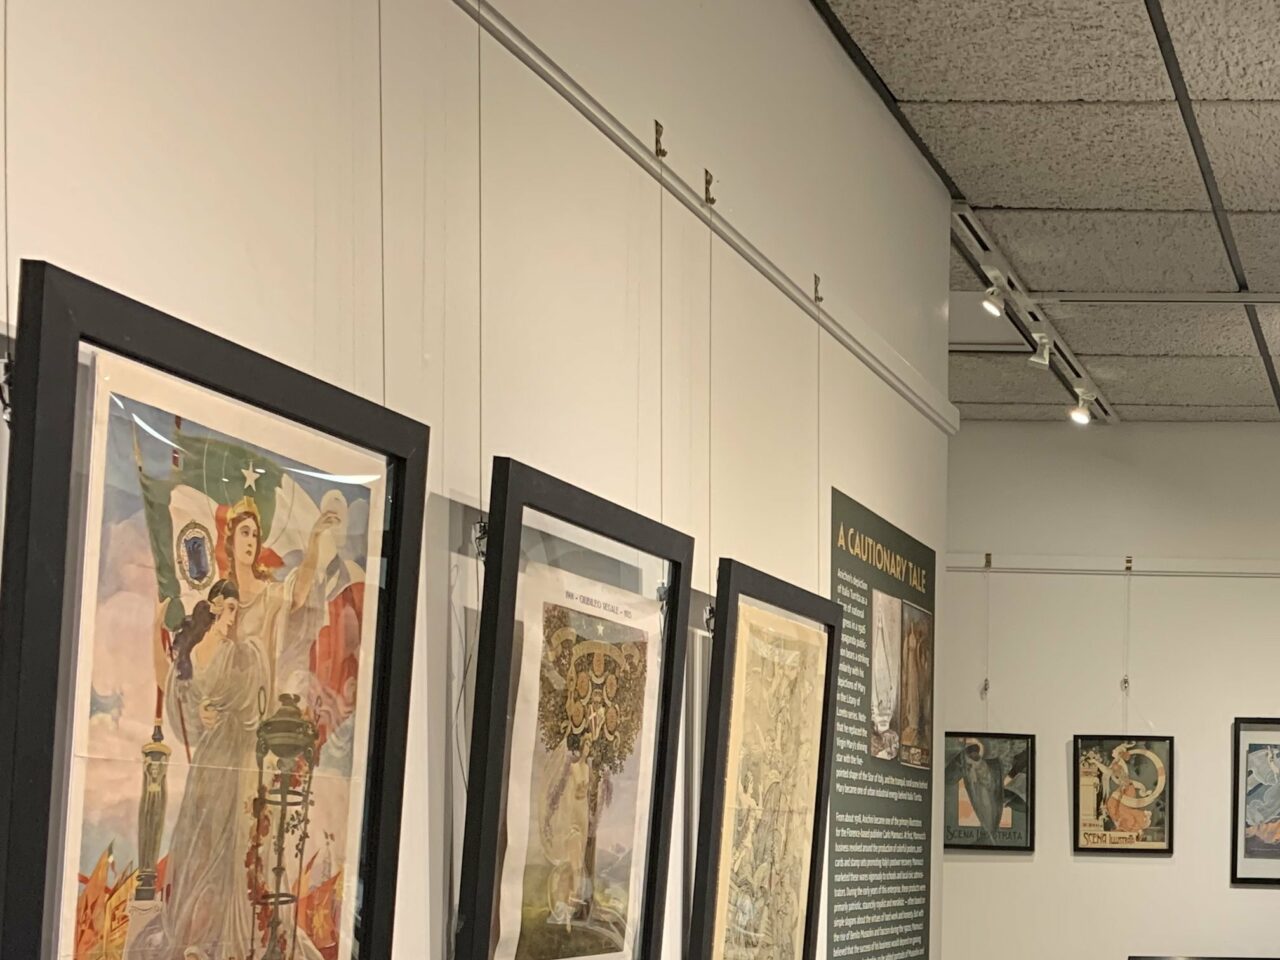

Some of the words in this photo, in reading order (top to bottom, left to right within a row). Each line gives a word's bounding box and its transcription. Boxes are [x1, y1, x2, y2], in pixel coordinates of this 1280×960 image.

[838, 522, 845, 550] A
[848, 528, 906, 582] CAUTIONARY
[908, 562, 925, 594] TALE
